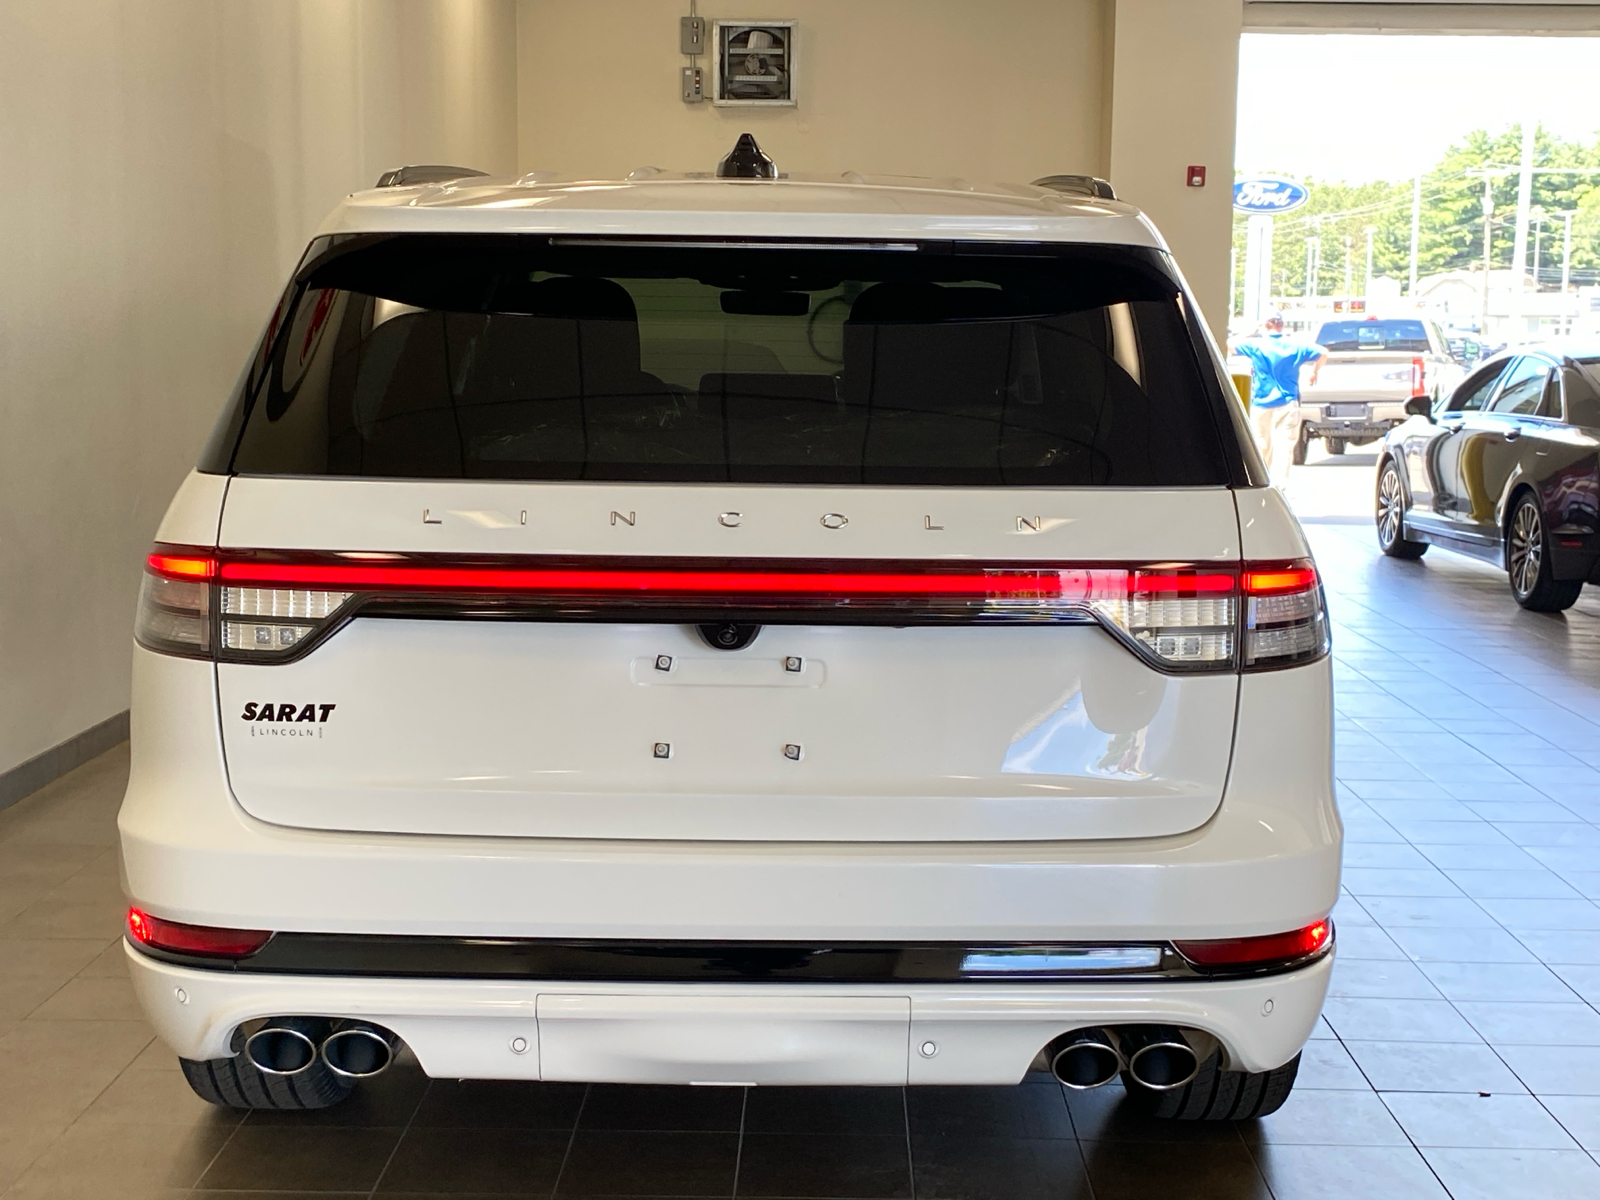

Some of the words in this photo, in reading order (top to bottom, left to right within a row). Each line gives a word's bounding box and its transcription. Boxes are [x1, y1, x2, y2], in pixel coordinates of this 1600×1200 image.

[1236, 182, 1292, 206] Ford
[423, 508, 1042, 533] LINCOLN
[241, 702, 336, 722] SARAT
[259, 728, 313, 736] LINCOLN
